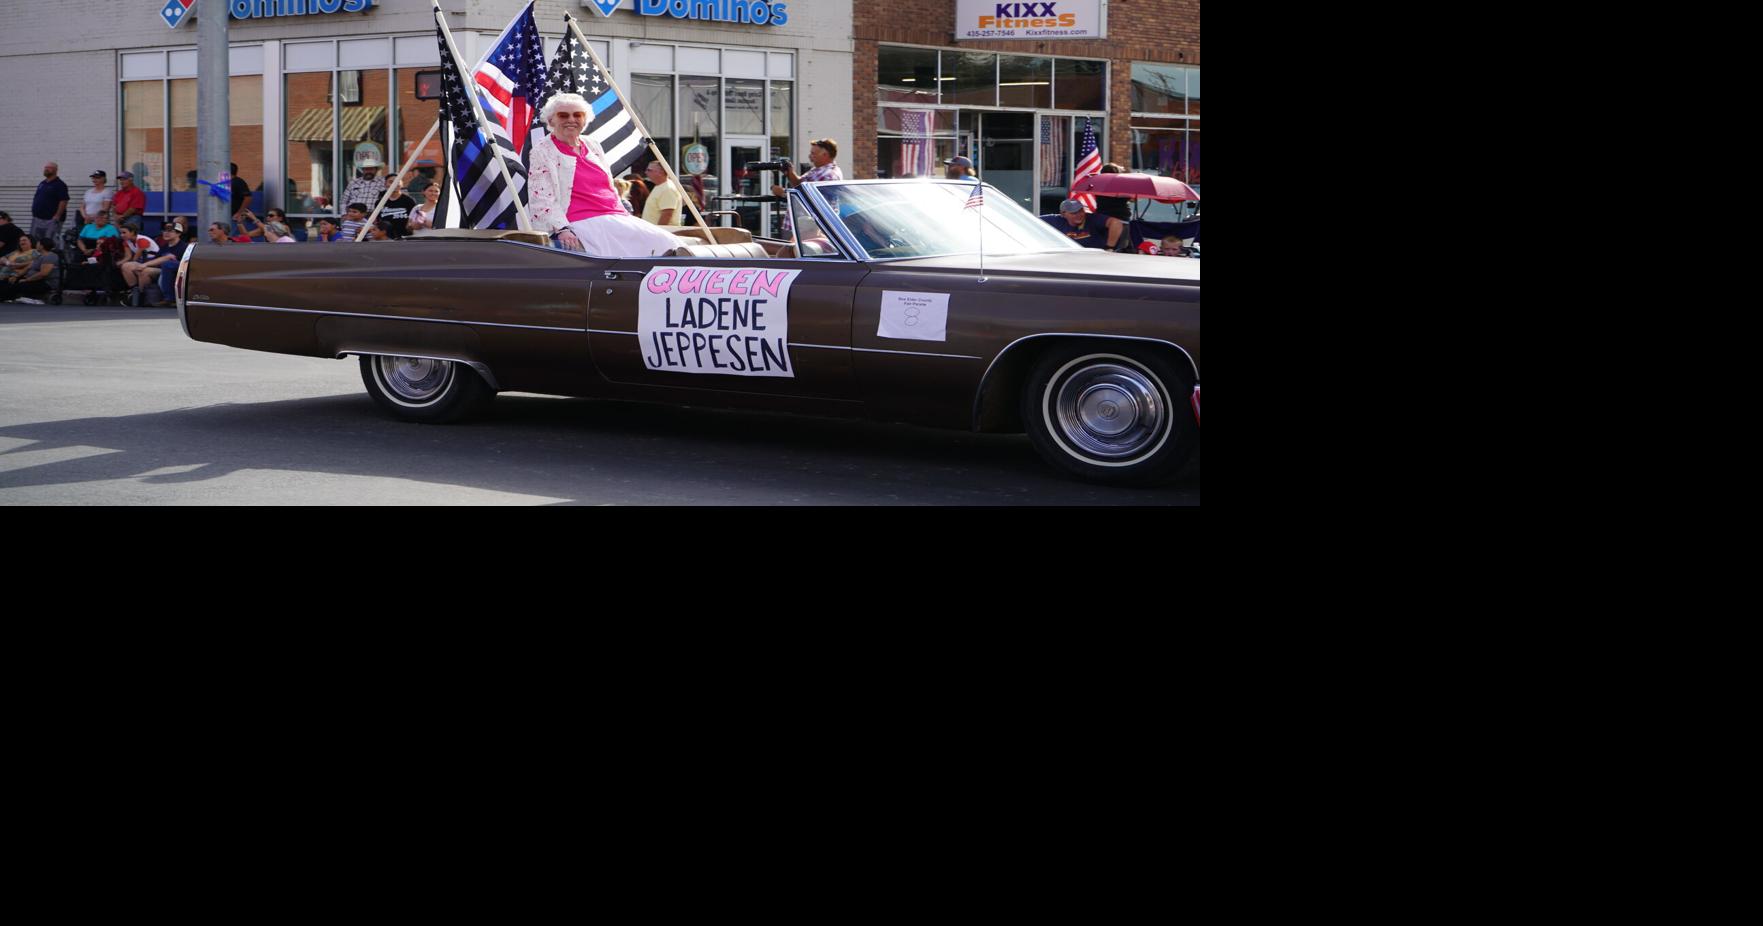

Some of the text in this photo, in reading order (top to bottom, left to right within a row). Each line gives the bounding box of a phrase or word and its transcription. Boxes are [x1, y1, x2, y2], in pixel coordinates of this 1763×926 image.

[996, 2, 1057, 18] KIXX
[647, 268, 790, 298] QUEEN
[665, 298, 768, 331] LADENE
[648, 331, 788, 373] JEPPESEN
